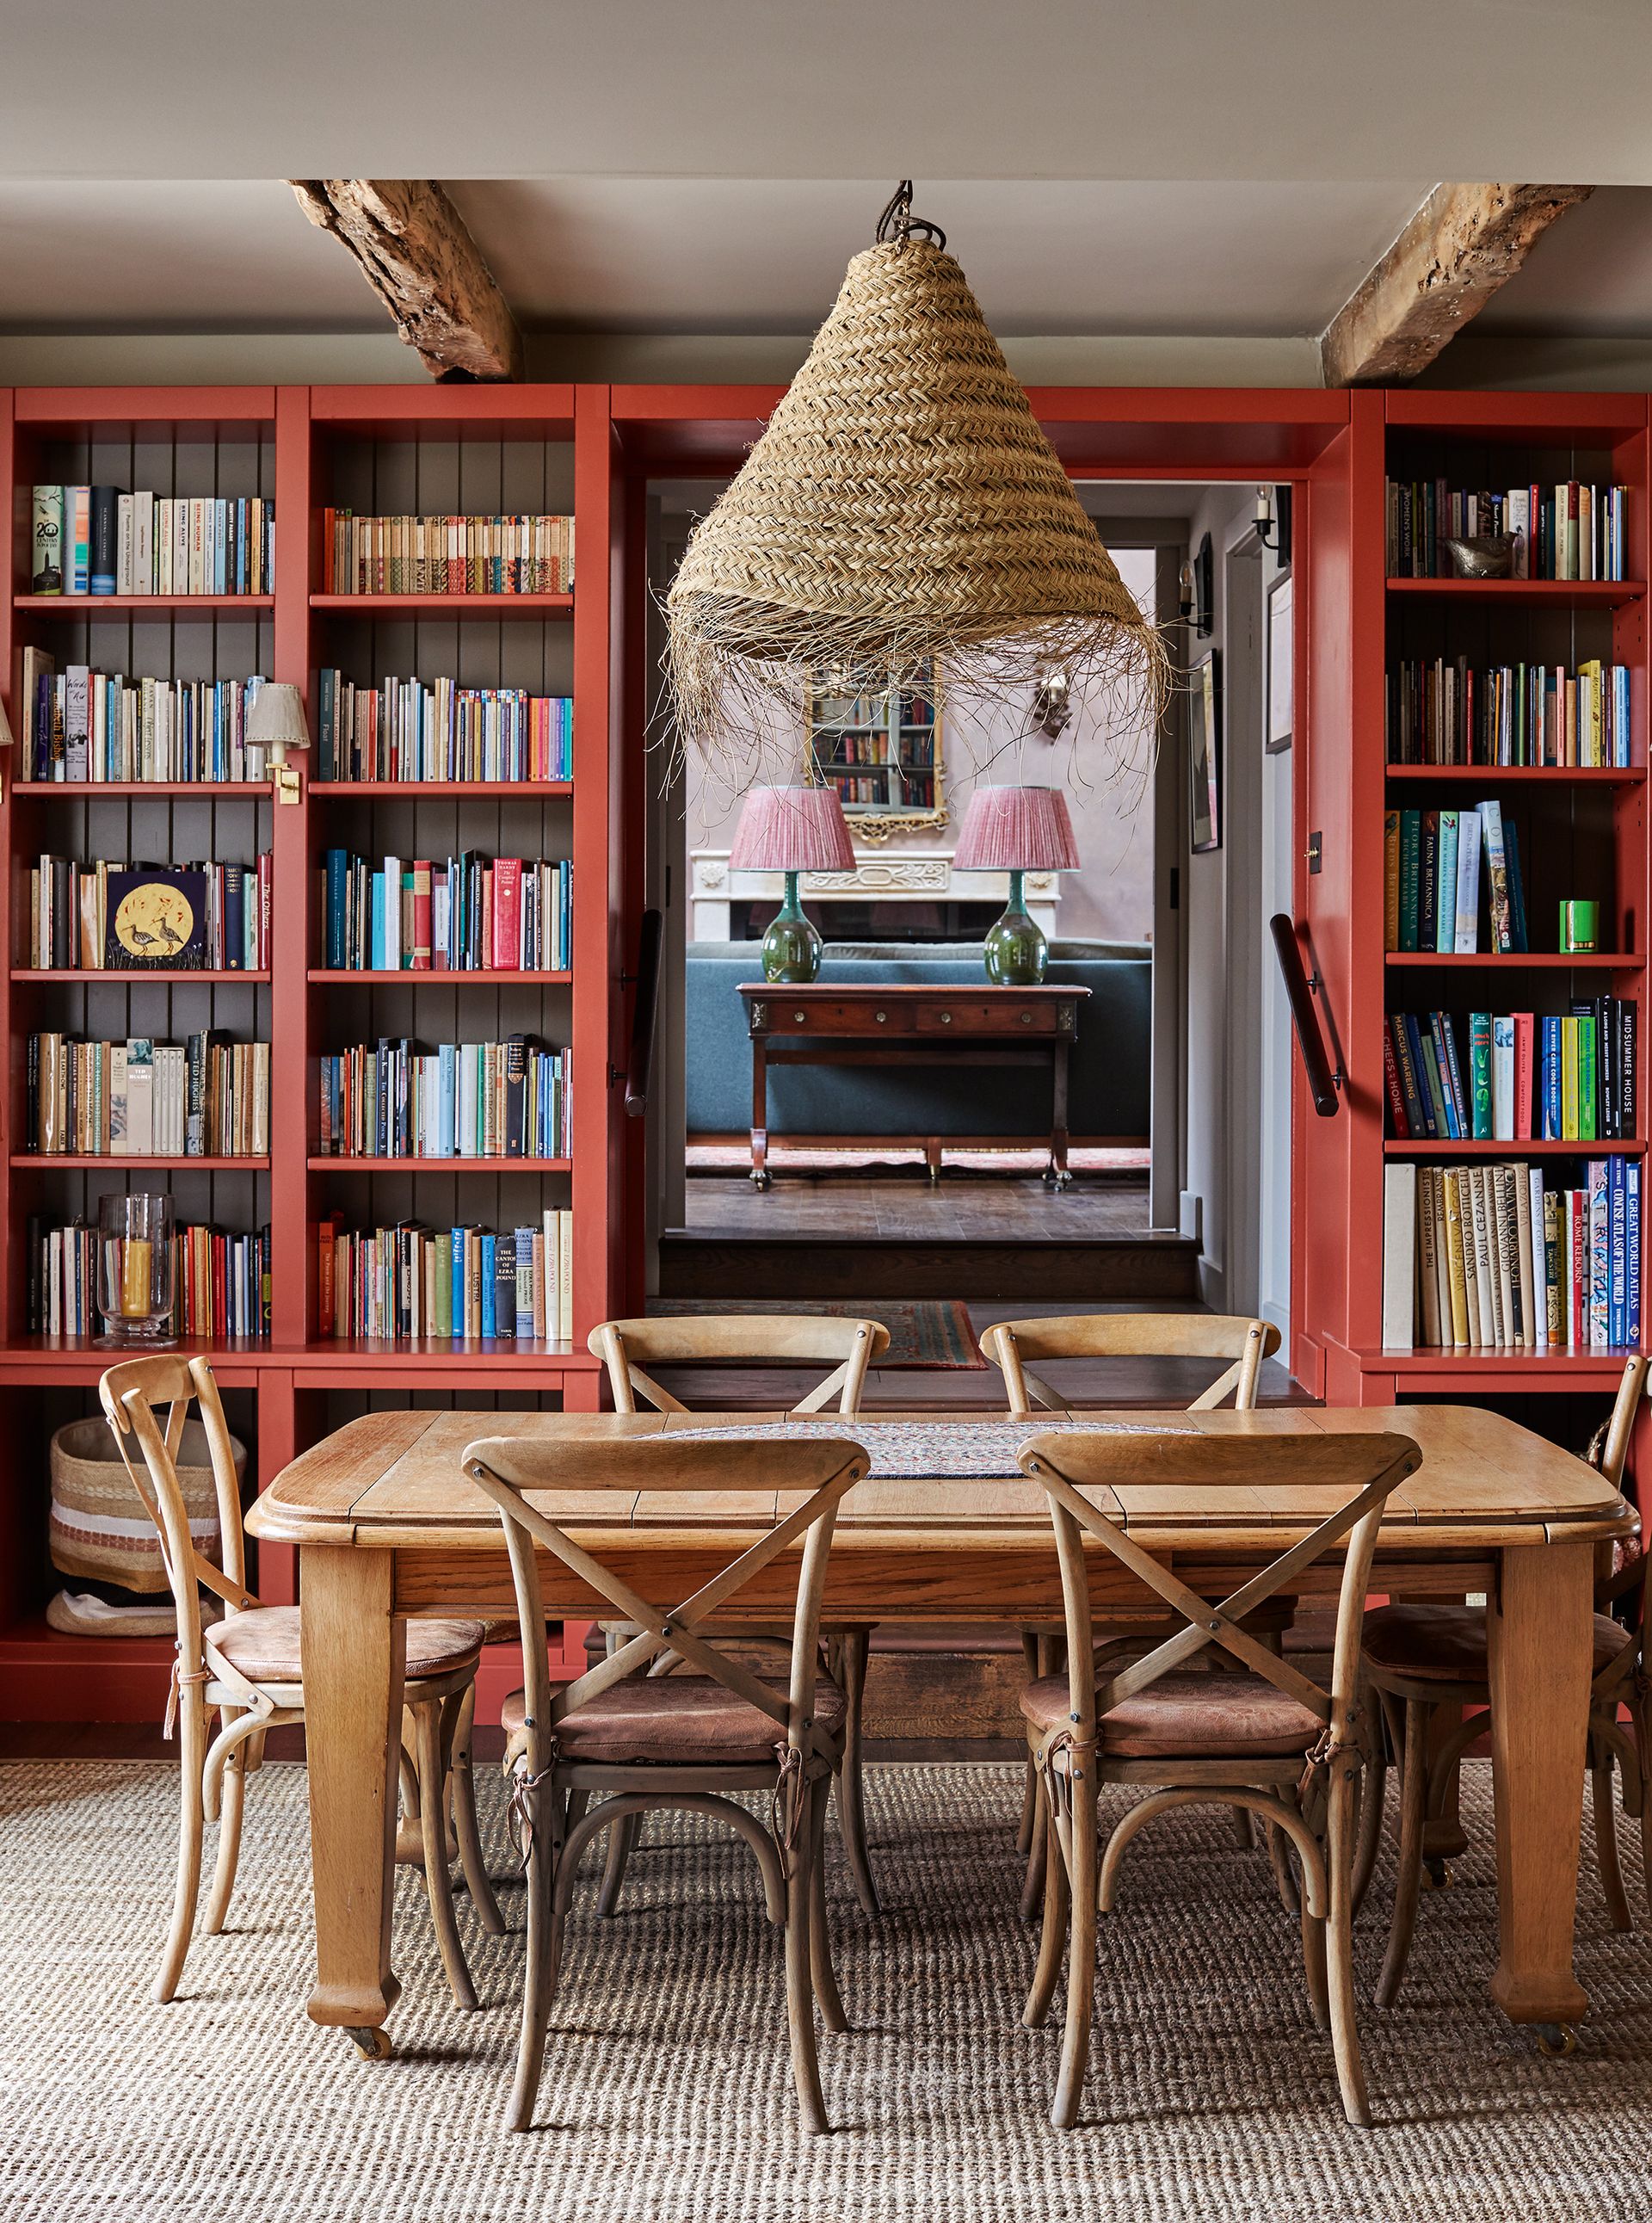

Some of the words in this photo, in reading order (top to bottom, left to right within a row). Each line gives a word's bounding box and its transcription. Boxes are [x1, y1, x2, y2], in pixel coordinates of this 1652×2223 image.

[53, 692, 64, 730] Elizabeth
[51, 735, 64, 763] Bishop
[1388, 835, 1397, 868] BIRDS
[1411, 821, 1420, 856] FLORA
[1448, 833, 1457, 861] BUGS
[1387, 874, 1396, 939] BRITANNICA
[1410, 862, 1420, 930] BRITANNICA
[1425, 868, 1433, 919] BRITANNICA
[1446, 868, 1456, 935] BRITANNICA
[1394, 1016, 1408, 1054] MARCUS
[1402, 1056, 1415, 1099] WAREING
[1448, 1045, 1457, 1074] Lawrence
[1624, 1016, 1632, 1075] MIDSUMMER
[1384, 1036, 1396, 1071] CHEFS
[1390, 1081, 1402, 1113] HOME
[1454, 1077, 1459, 1086] ON
[487, 1068, 495, 1132] NOTEBOOK
[1455, 1088, 1464, 1114] BAKING
[1624, 1079, 1632, 1113] HOUSE
[1435, 1171, 1445, 1222] REMBRANDT
[1459, 1169, 1474, 1227] BOTTICELLI
[1473, 1171, 1486, 1232] CEZANNE
[1486, 1170, 1495, 1216] DRAWINGS
[1495, 1169, 1506, 1211] BELLINI
[1506, 1172, 1516, 1203] VINC
[1519, 1167, 1529, 1226] VELAZQUEZ
[1534, 1178, 1542, 1217] GARDENS
[1613, 1188, 1624, 1220] CONCISE
[1422, 1170, 1433, 1249] IMPRESSIONISTS
[1451, 1212, 1463, 1238] VAN
[1507, 1207, 1518, 1220] DA
[1630, 1198, 1639, 1233] GREAT
[1490, 1221, 1498, 1239] AND
[1498, 1216, 1511, 1272] GIOVANNI
[1574, 1215, 1582, 1243] ROME
[1595, 1181, 1606, 1305] STRATA
[1613, 1221, 1624, 1247] ATLAS
[1426, 1252, 1434, 1268] THE
[1454, 1239, 1465, 1291] VINCENT
[1464, 1231, 1476, 1280] SANDRO
[1478, 1238, 1489, 1267] PAUL
[1491, 1243, 1501, 1291] PAINTINGS
[1508, 1226, 1520, 1288] LEONARDO
[1574, 1245, 1582, 1283] REBORN
[1613, 1247, 1624, 1257] OF
[1613, 1258, 1624, 1275] THE
[1630, 1235, 1639, 1275] WORLD
[1613, 1276, 1624, 1304] WORLD
[1630, 1277, 1639, 1309] ATLAS
[1494, 1295, 1504, 1340] RAPHAEL'S
